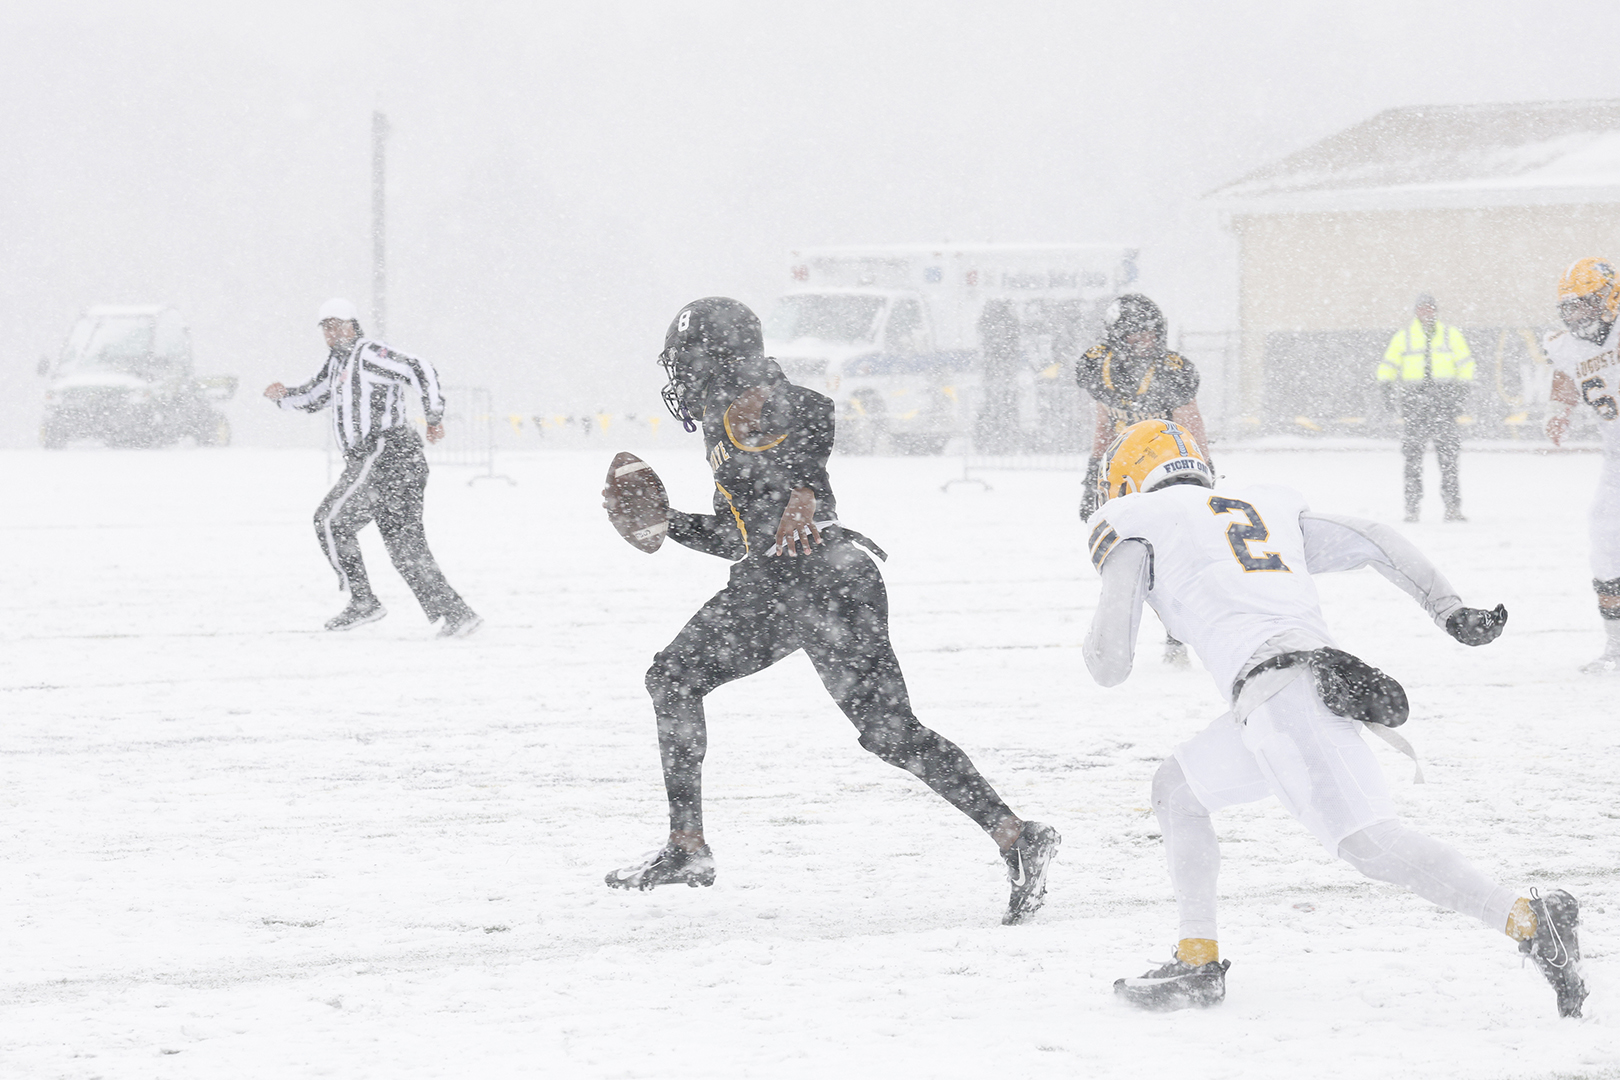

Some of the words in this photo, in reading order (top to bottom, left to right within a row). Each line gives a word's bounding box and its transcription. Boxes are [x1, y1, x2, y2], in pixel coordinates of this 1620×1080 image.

[678, 310, 691, 333] 8
[1576, 351, 1620, 379] AUGUST
[1581, 375, 1620, 421] 6
[1163, 459, 1195, 474] FIGHT
[1207, 496, 1293, 573] 2
